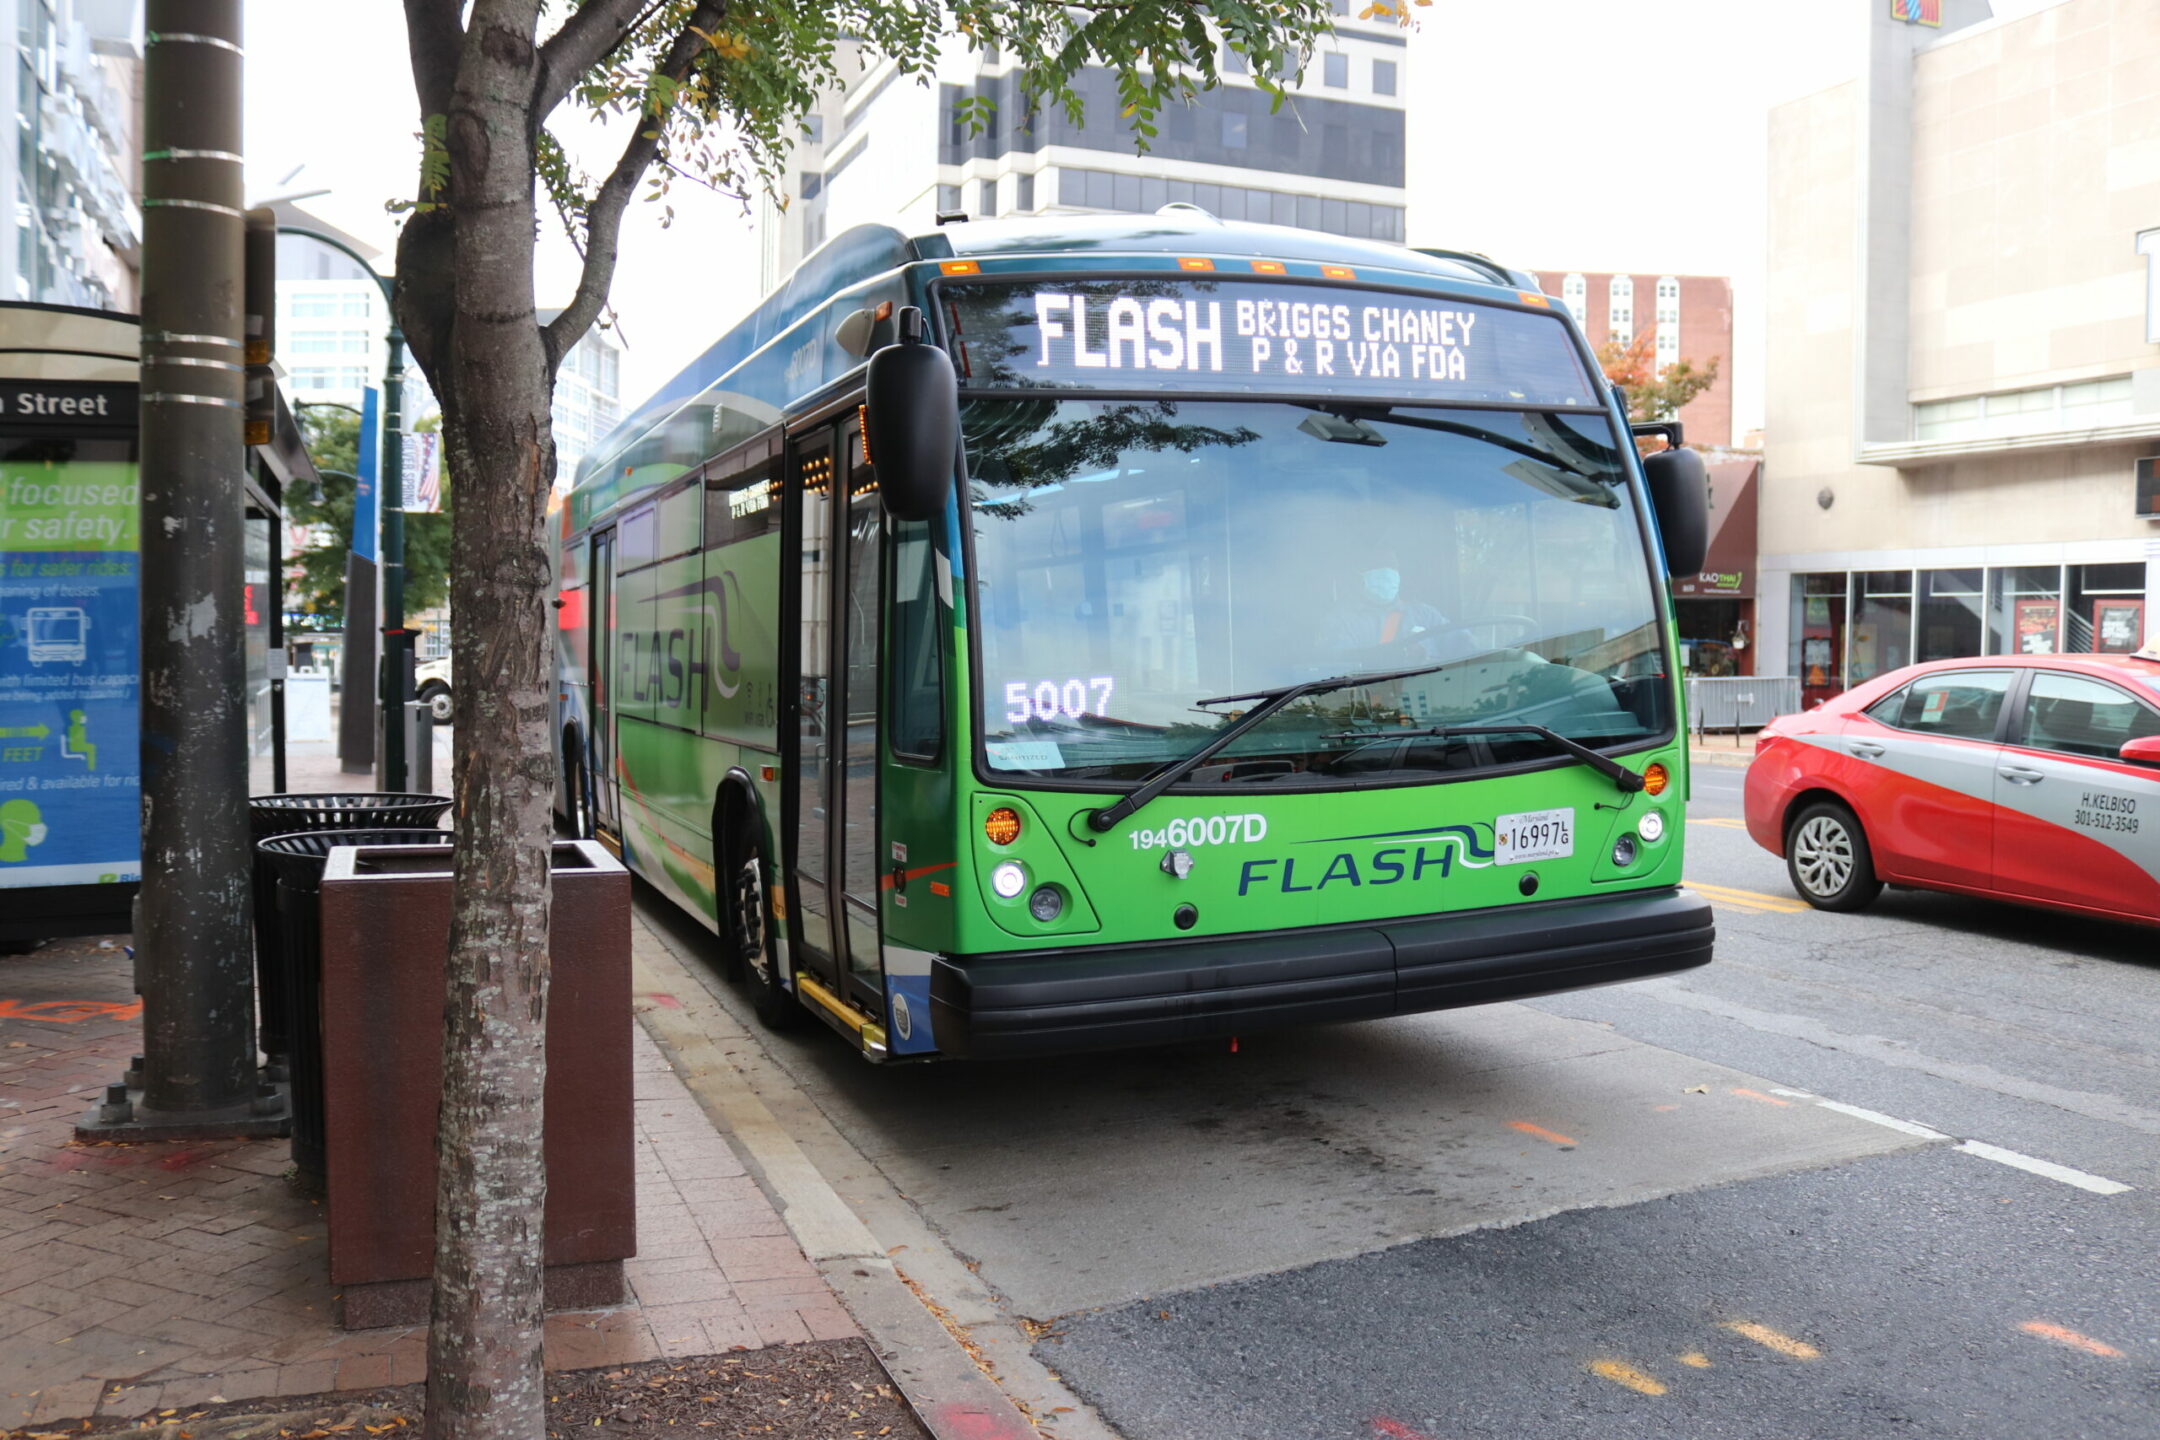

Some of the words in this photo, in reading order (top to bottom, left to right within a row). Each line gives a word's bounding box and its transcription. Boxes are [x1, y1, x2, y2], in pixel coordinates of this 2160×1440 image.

[1035, 293, 1222, 371] FLASH
[1237, 299, 1350, 340] BRIGGS
[1363, 306, 1475, 346] CHANEY
[1252, 337, 1271, 373] P
[1284, 338, 1303, 374] &
[1316, 340, 1335, 375] R
[1347, 341, 1401, 378] VIA
[1411, 344, 1466, 381] FDA
[17, 393, 108, 415] Street
[10, 477, 140, 505] focused
[24, 510, 129, 546] safety.
[620, 627, 711, 712] FLASH
[1006, 677, 1113, 723] 5007
[3, 747, 43, 762] FEET
[26, 776, 38, 791] &
[41, 775, 100, 790] available
[104, 774, 122, 787] for
[2082, 792, 2136, 814] H.KELBISO
[1512, 822, 1560, 851] 16997
[2075, 809, 2139, 834] 301-512-3549
[1238, 844, 1454, 896] FLASH
